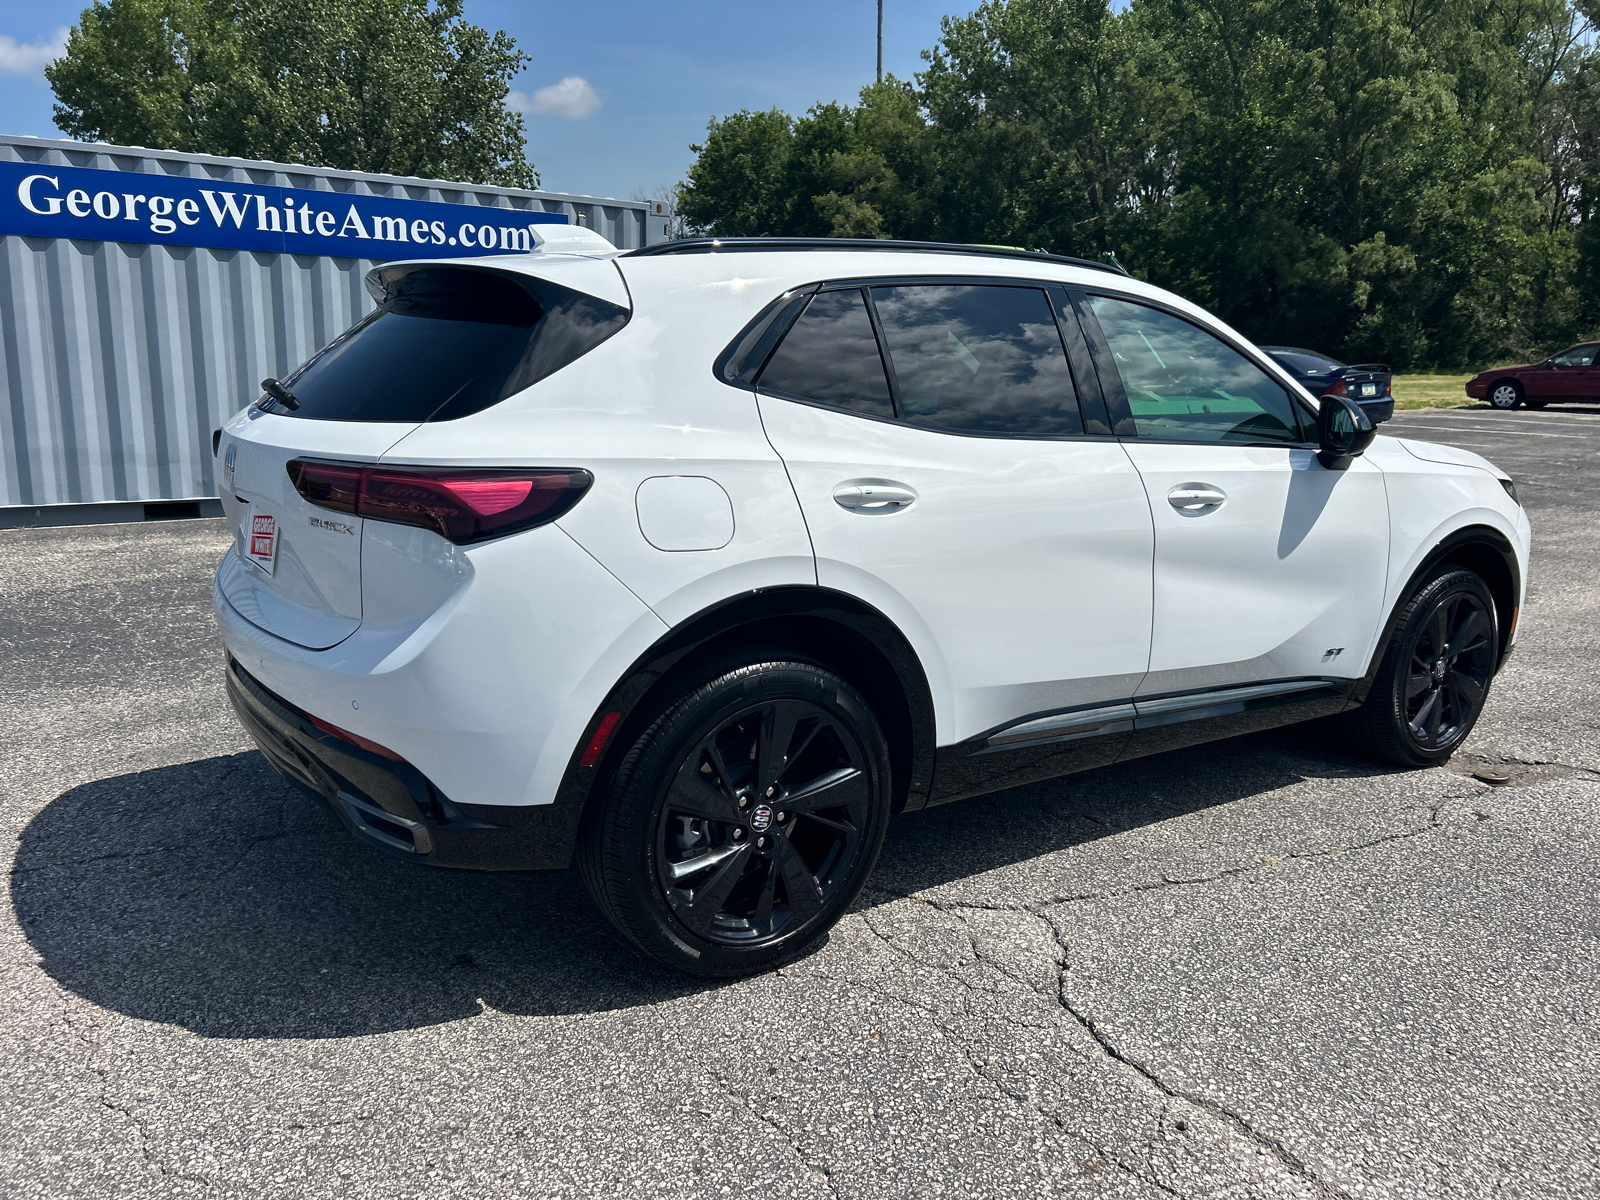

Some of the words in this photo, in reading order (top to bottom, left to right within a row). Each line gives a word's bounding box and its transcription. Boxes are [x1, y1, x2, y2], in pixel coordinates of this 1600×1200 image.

[17, 174, 531, 251] GeorgeWhiteAmes.com
[254, 517, 274, 534] GEORGE
[309, 516, 354, 535] BUICK
[1323, 647, 1345, 656] ST
